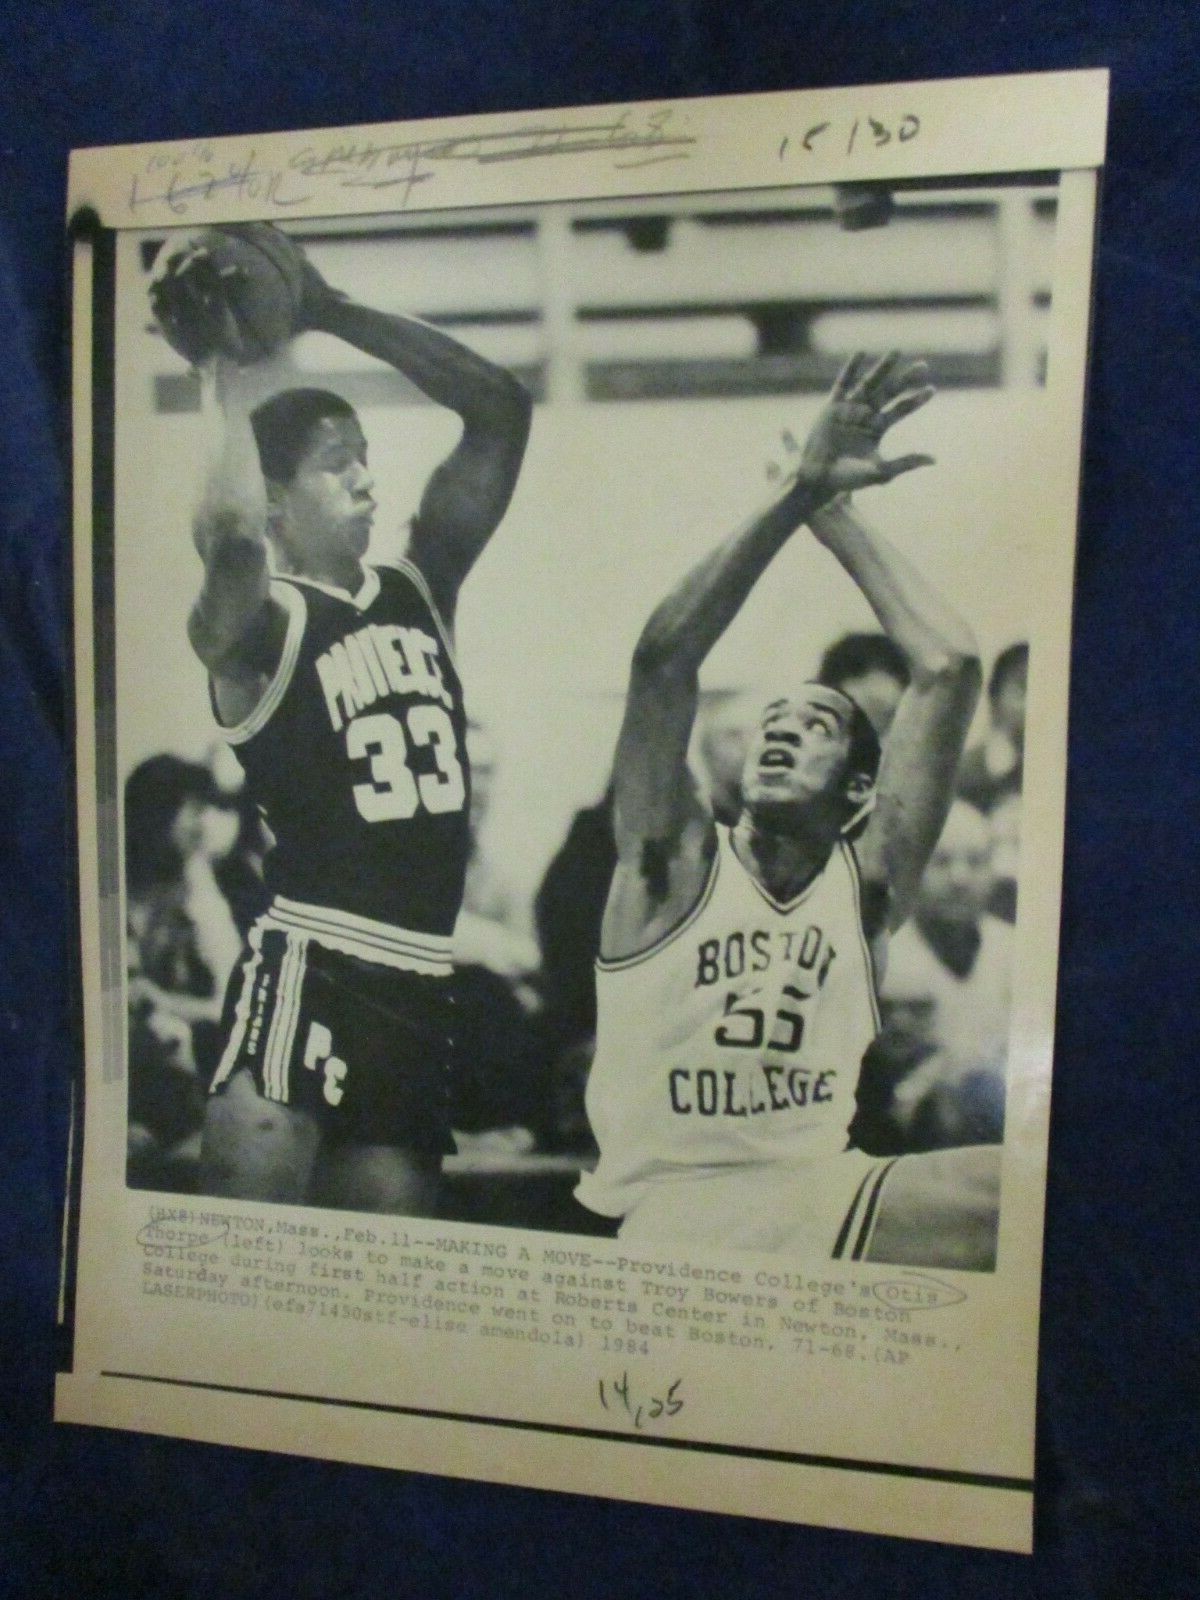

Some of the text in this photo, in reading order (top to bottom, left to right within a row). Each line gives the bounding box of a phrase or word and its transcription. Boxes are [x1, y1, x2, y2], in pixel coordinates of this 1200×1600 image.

[345, 703, 466, 823] 33
[714, 985, 811, 1053] 55
[143, 1244, 220, 1266] College
[230, 1254, 297, 1275] during
[310, 1262, 365, 1282] first
[376, 1269, 423, 1288] half
[435, 1278, 505, 1299] action
[517, 1287, 541, 1303] at
[555, 1290, 639, 1314] Roberts
[652, 1302, 729, 1324] Center
[742, 1313, 766, 1330] in
[143, 1261, 230, 1288] Saturday
[364, 1288, 481, 1316] Providence
[491, 1306, 541, 1323] went
[552, 1312, 577, 1326] on
[591, 1315, 614, 1331] to
[627, 1318, 676, 1339] beat
[145, 1226, 913, 1324] Thorpe (left) looks to make a move against Troy Bowers of Boston
[518, 1246, 531, 1262] A
[755, 1270, 871, 1298] College's
[886, 1284, 938, 1308] Otis
[602, 1335, 650, 1355] 1984
